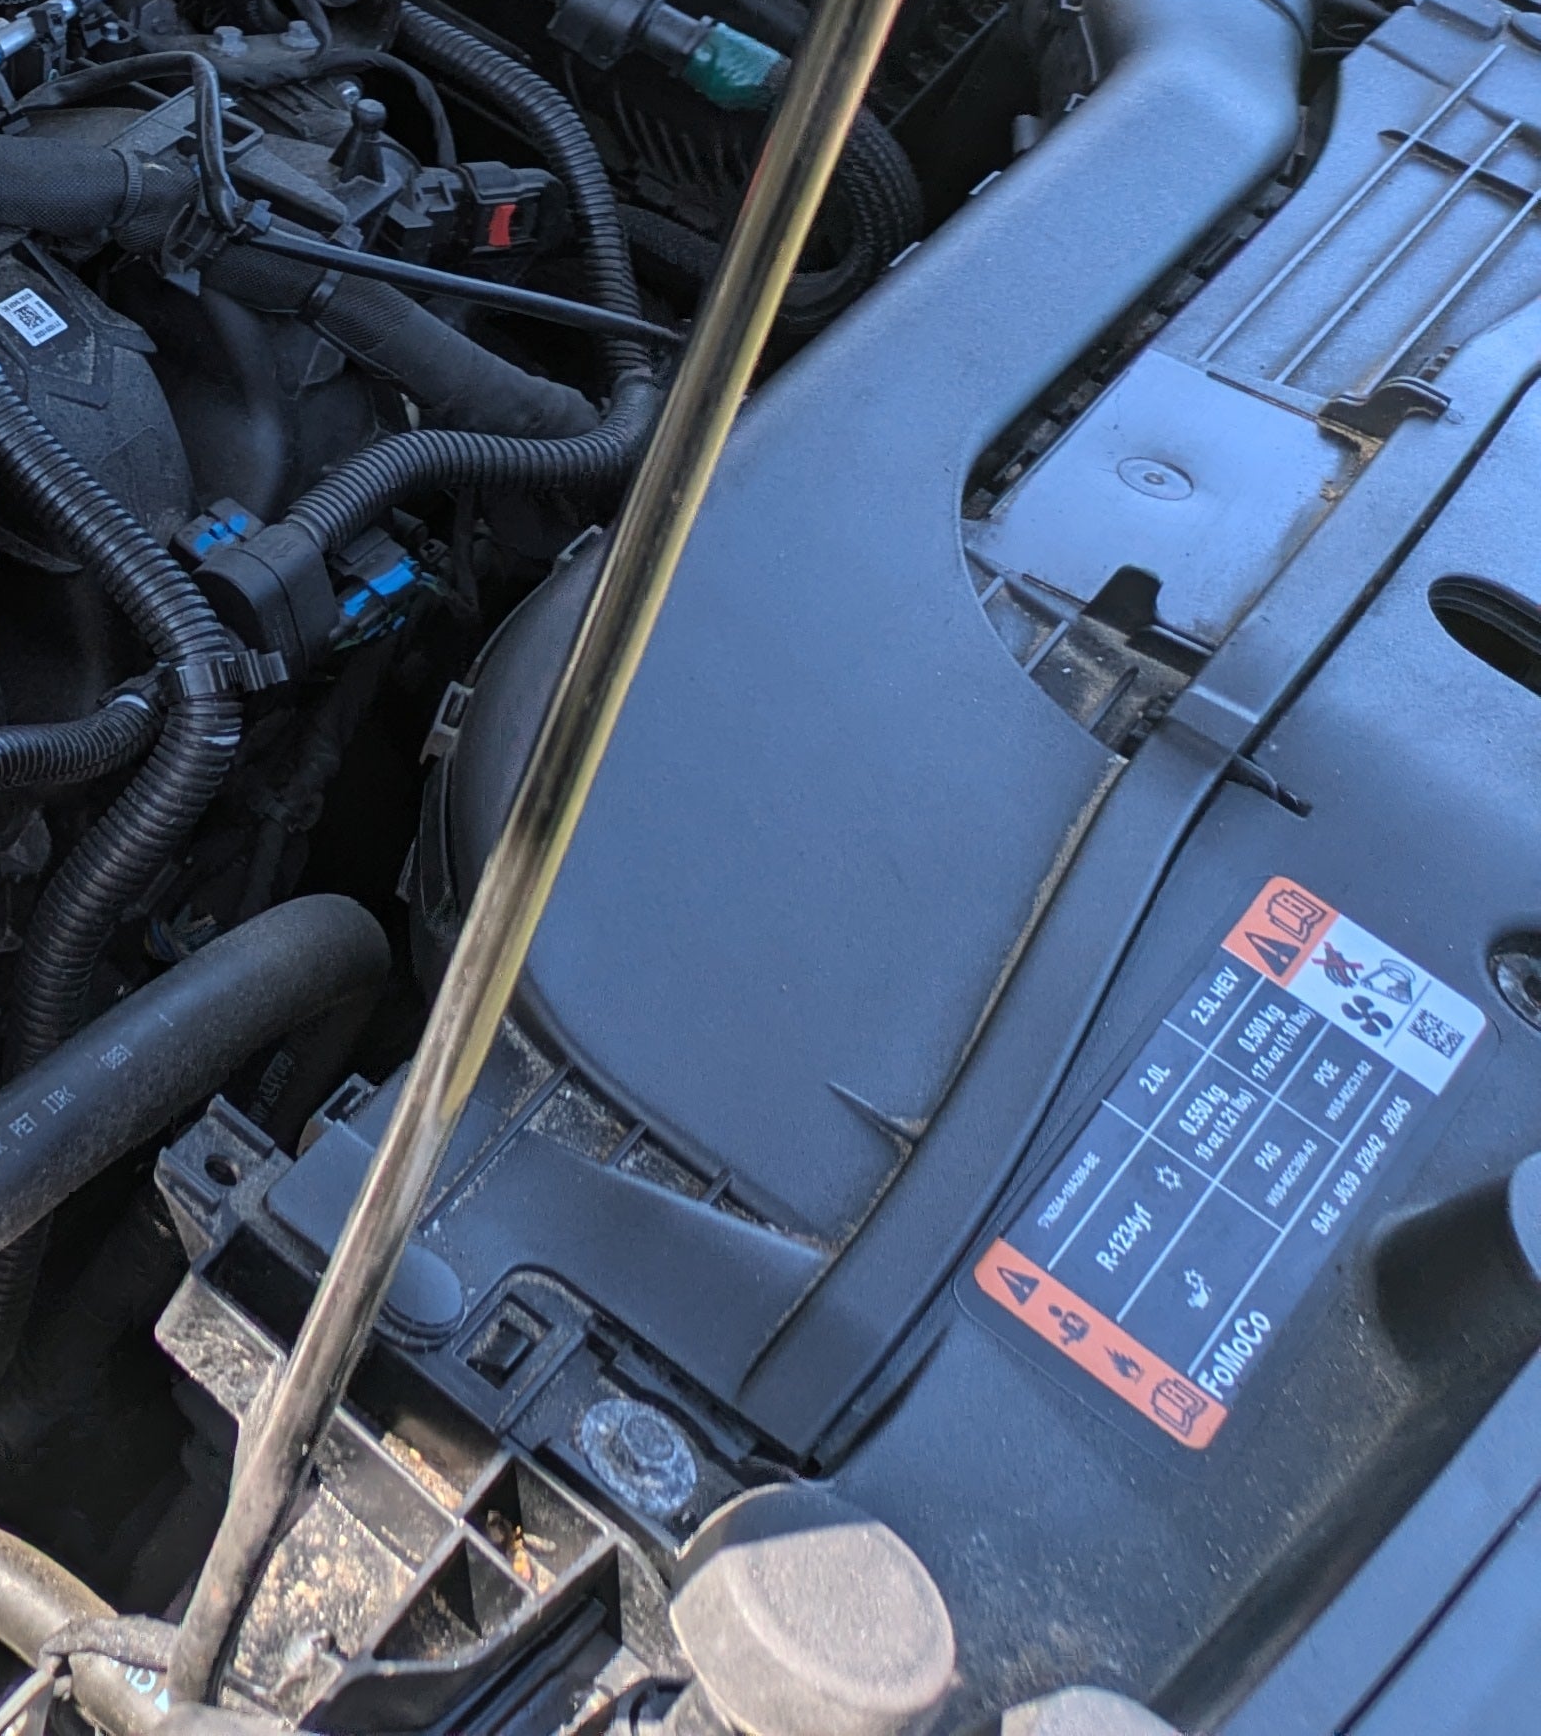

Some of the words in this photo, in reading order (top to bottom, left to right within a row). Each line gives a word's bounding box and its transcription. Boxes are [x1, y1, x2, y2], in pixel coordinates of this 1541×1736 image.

[1190, 996, 1222, 1026] 2.5L
[1209, 966, 1240, 1000] HEV
[1237, 1016, 1272, 1054] 0.500
[1258, 1003, 1287, 1025] kg
[1138, 1063, 1171, 1095] 2.0L
[1251, 1056, 1276, 1081] 17.6
[1268, 1045, 1285, 1063] oz
[1313, 1058, 1340, 1088] POE
[1178, 1097, 1214, 1136] 0.550
[1200, 1084, 1230, 1106] kg
[1195, 1142, 1214, 1162] 19
[1207, 1131, 1225, 1150] oz
[1254, 1141, 1282, 1172] PAG
[1310, 1201, 1341, 1235] SAE
[1332, 1170, 1361, 1206] J639
[1354, 1133, 1387, 1174] J2842
[1380, 1095, 1412, 1136] J2845
[1095, 1201, 1152, 1273] R-1234yf
[1197, 1310, 1271, 1401] FoMoCo
